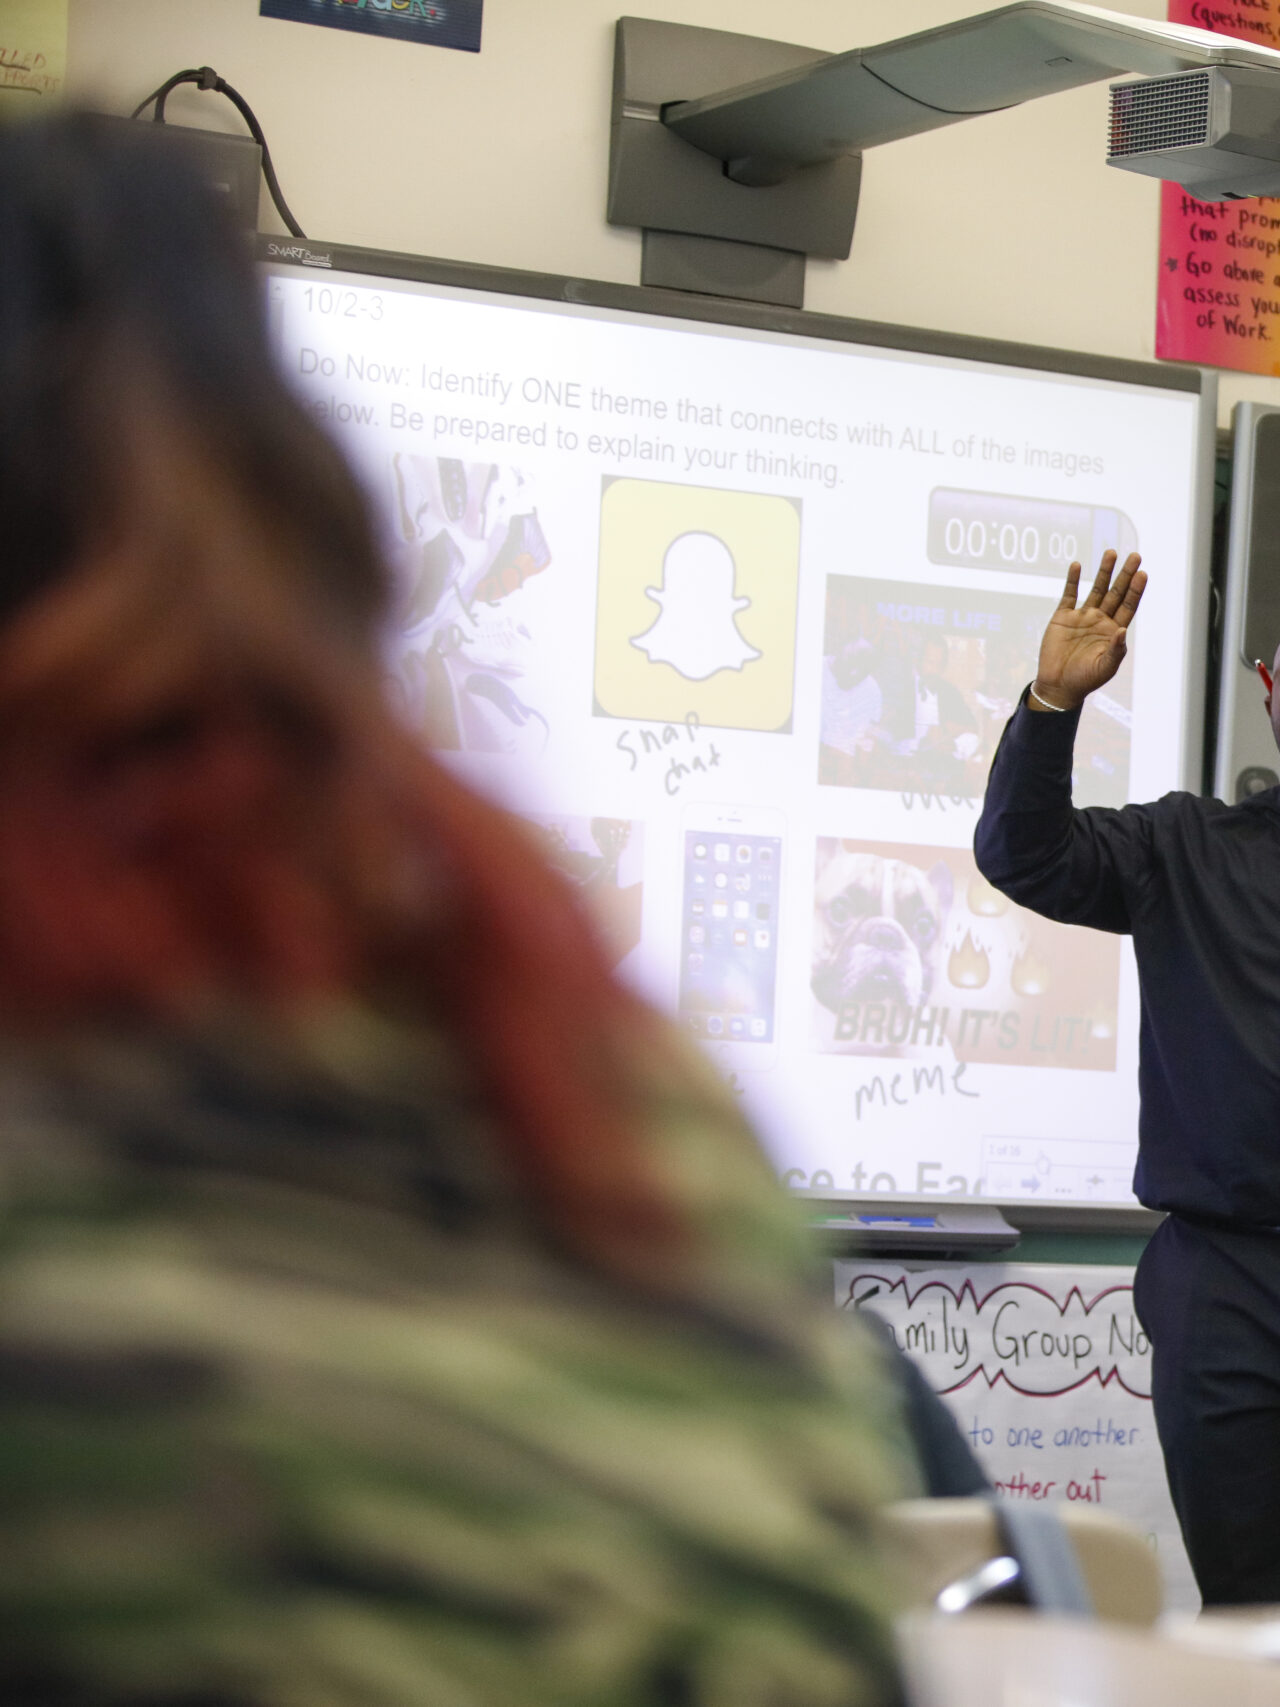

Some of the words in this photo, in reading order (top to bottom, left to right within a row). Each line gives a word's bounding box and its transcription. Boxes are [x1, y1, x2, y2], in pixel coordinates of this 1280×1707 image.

[1180, 197, 1229, 218] that
[268, 243, 304, 258] SMART
[1186, 251, 1212, 276] Go
[1223, 260, 1265, 284] above
[303, 287, 384, 321] 10/2-3
[1183, 286, 1240, 307] assess
[1196, 309, 1215, 328] of
[300, 348, 335, 377] Do
[347, 354, 410, 387] Now:
[422, 364, 513, 404] Identify
[522, 378, 581, 408] ONE
[591, 386, 667, 420] theme
[677, 397, 723, 427] that
[730, 407, 838, 442] connects
[846, 421, 893, 449] with
[900, 426, 945, 456] ALL
[952, 435, 975, 459] of
[981, 438, 1017, 463] the
[1024, 443, 1105, 477] images
[390, 403, 424, 431] Be
[434, 413, 547, 448] prepared
[556, 425, 579, 451] to
[587, 433, 676, 468] explain
[684, 445, 738, 471] your
[746, 449, 845, 489] thinking.
[945, 518, 1040, 563] 00:00
[1048, 532, 1077, 560] 00
[877, 602, 945, 626] MORE
[952, 610, 1002, 632] LIFE
[834, 1002, 948, 1047] BRUH!
[956, 1008, 1020, 1050] IT'S
[855, 1062, 980, 1121] meme
[993, 1301, 1092, 1368] Group
[968, 1416, 993, 1446] to
[1007, 1427, 1043, 1449] one
[1054, 1419, 1140, 1447] another
[1066, 1469, 1107, 1502] out
